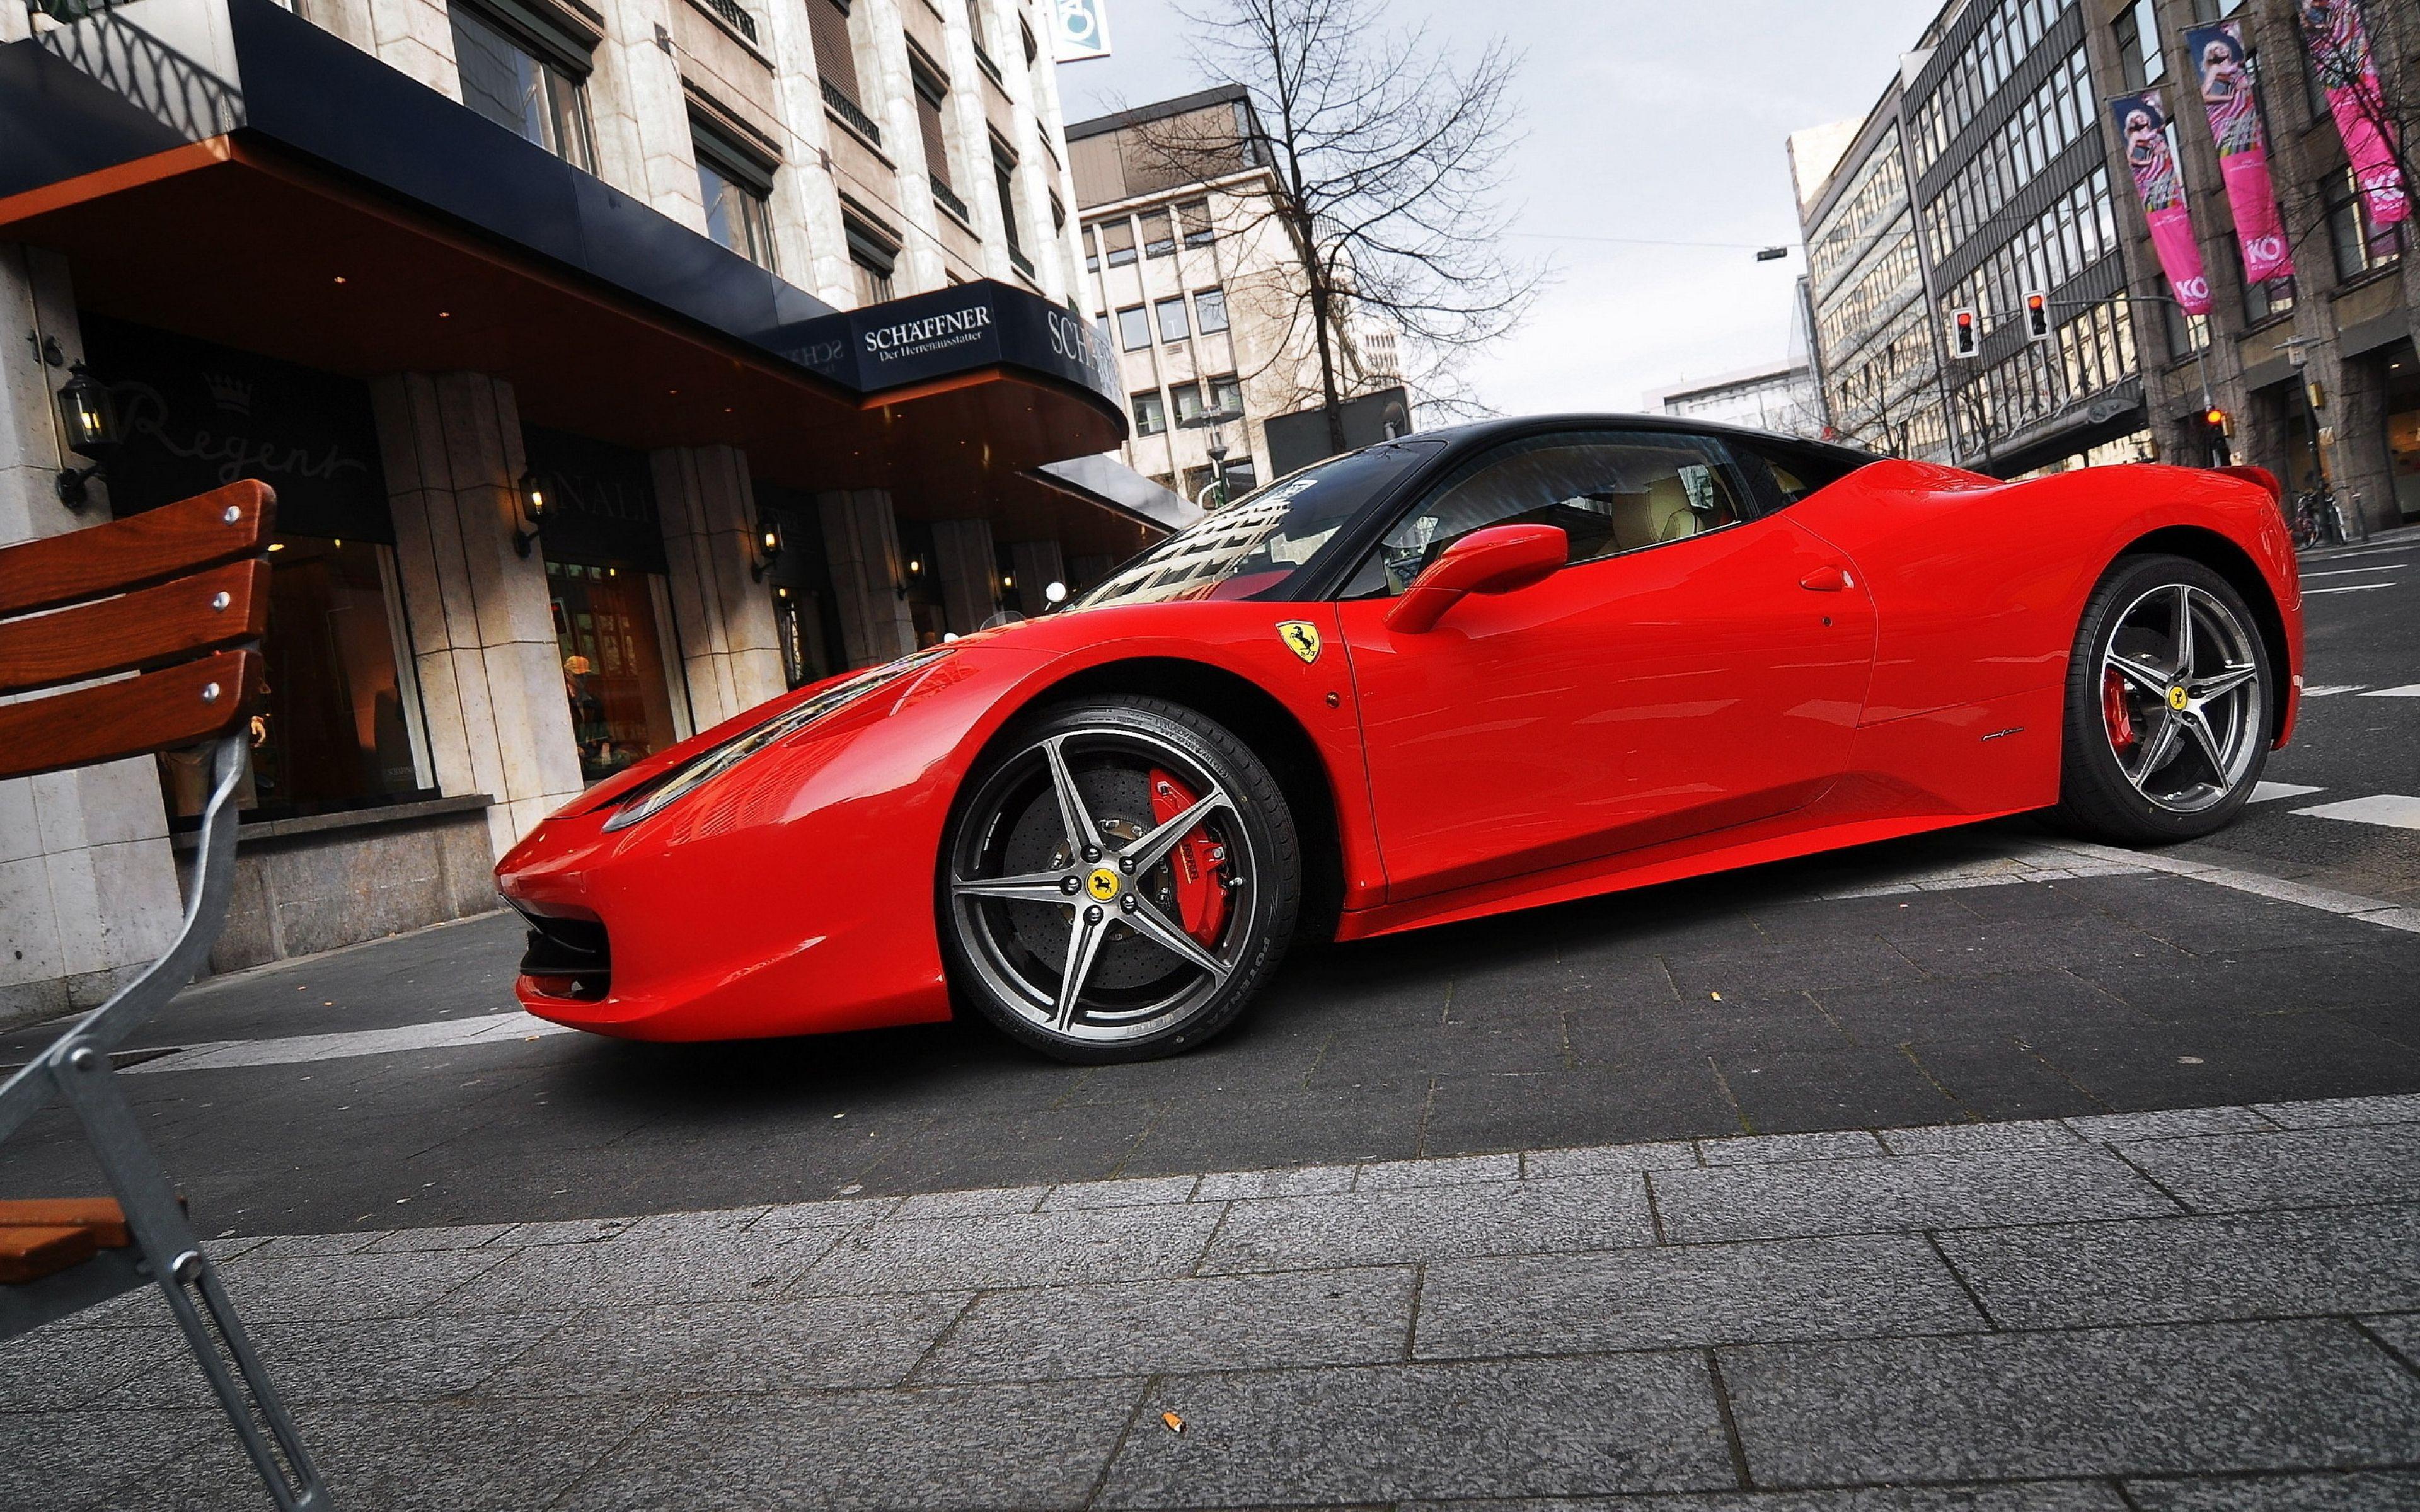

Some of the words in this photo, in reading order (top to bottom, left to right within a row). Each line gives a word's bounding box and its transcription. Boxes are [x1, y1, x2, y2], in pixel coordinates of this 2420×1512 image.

[865, 306, 991, 352] SCHÄFFNER
[880, 350, 899, 362] Der
[901, 331, 982, 357] Herrenausstatter
[110, 378, 367, 484] Regent
[551, 470, 650, 524] NALI
